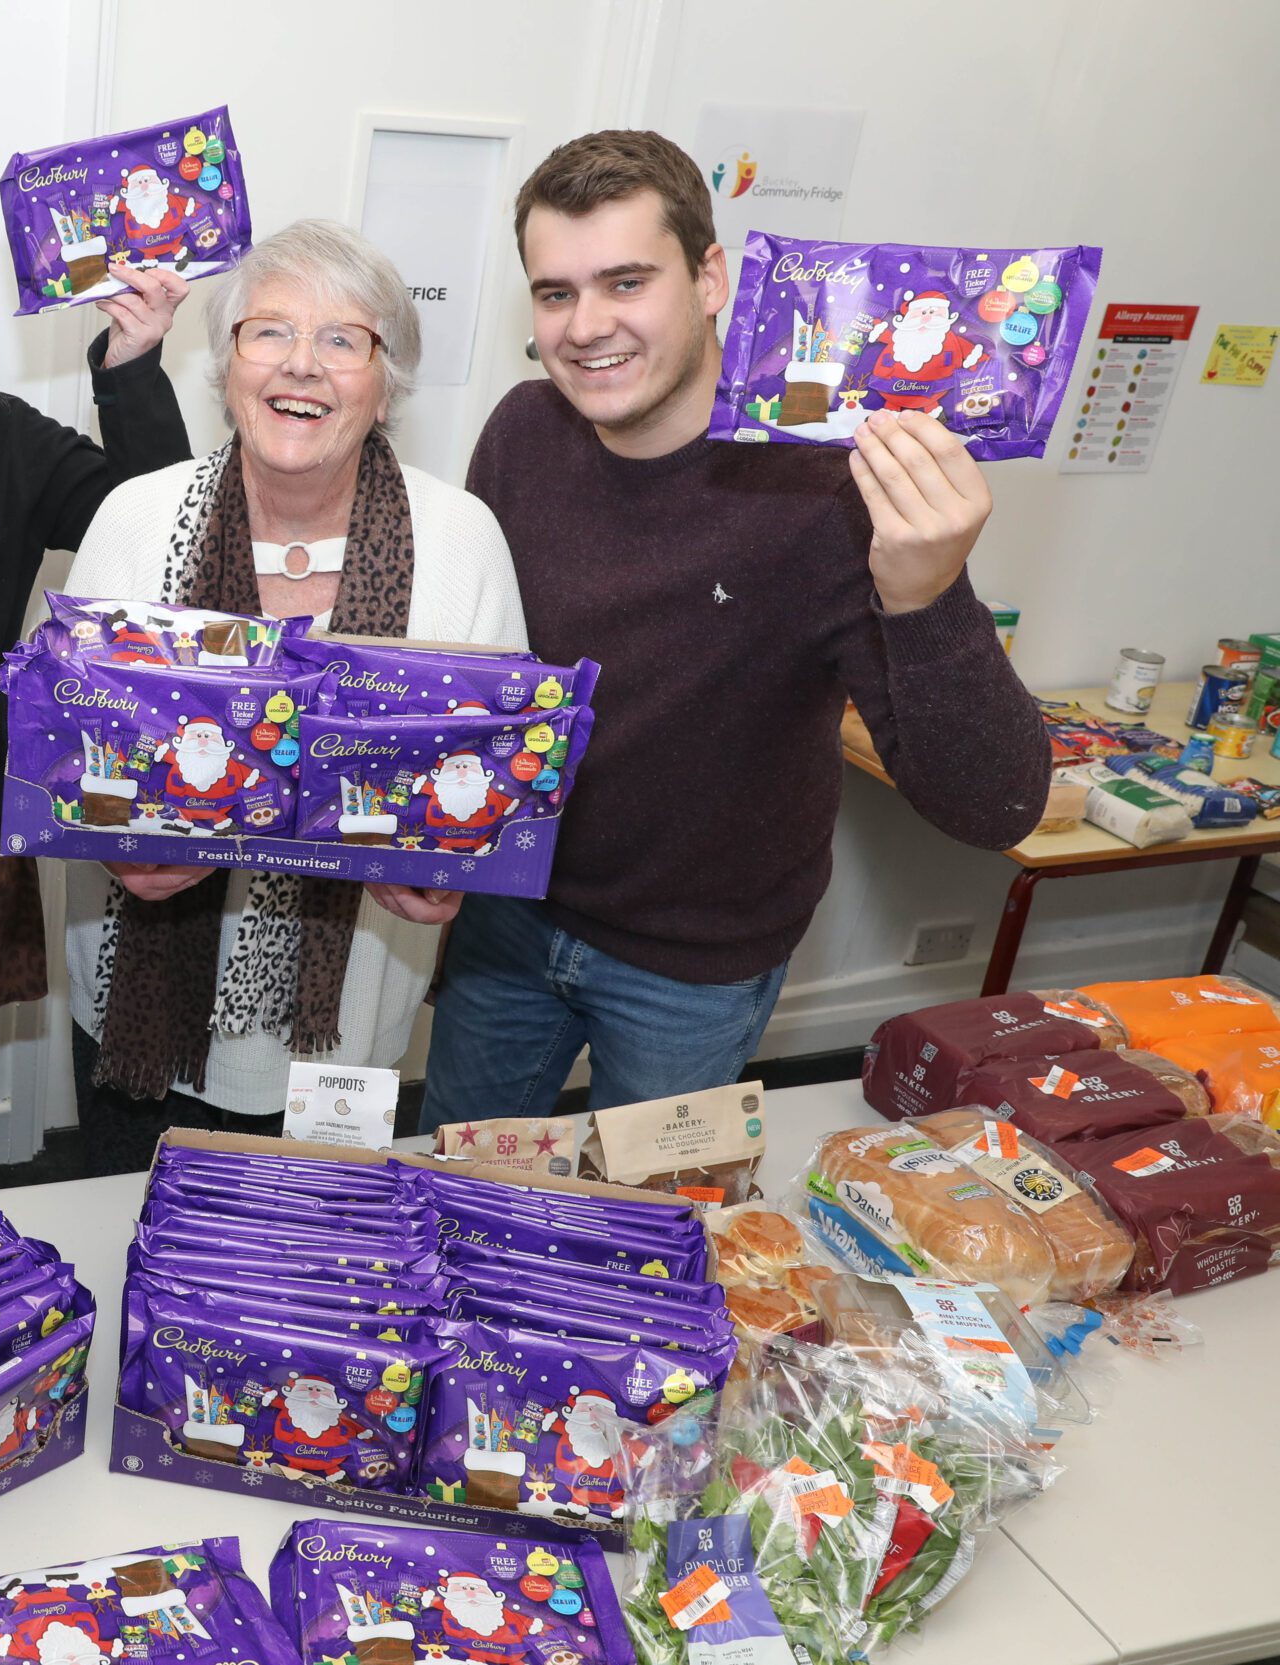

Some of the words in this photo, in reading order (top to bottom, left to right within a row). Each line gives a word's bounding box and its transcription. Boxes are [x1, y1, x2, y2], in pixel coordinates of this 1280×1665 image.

[157, 141, 178, 153] FREE
[19, 164, 88, 192] Cadbury
[752, 184, 810, 200] Community
[810, 186, 843, 202] Fridge
[773, 252, 867, 294] Cadbury
[966, 268, 992, 280] FREE
[965, 279, 987, 288] Ticket
[1114, 310, 1141, 322] Allergy
[1143, 312, 1185, 321] Awareness
[893, 380, 930, 393] Cadbury
[502, 686, 526, 696] FREE
[54, 678, 139, 718] Cadbury
[501, 695, 524, 703] Ticket
[231, 701, 256, 711] FREE
[232, 710, 255, 718] Ticket
[491, 733, 516, 742] FREE
[310, 733, 402, 759] Cadbury
[186, 797, 217, 808] Cadbury
[446, 827, 476, 836] Cadbury
[197, 851, 252, 862] Festive
[257, 853, 341, 870] Favourites!
[994, 1019, 1046, 1037] BAKERY
[318, 1075, 366, 1093] POPDOTS
[898, 1072, 932, 1100] BAKERY
[1083, 1089, 1141, 1103] BAKERY
[665, 1119, 702, 1131] BAKERY
[660, 1135, 676, 1144] MILK
[678, 1129, 716, 1141] CHOCOLATE
[659, 1143, 674, 1151] BALL
[676, 1136, 716, 1149] DOUGHNUTS
[844, 1183, 893, 1230] Danish
[606, 1259, 631, 1272] FREE
[1205, 1256, 1236, 1277] TOASTIE
[955, 1315, 984, 1323] STICKY
[955, 1320, 992, 1330] MUFFINS
[12, 1331, 32, 1346] FREE
[153, 1326, 247, 1367] Cadbury
[346, 1364, 372, 1378] FREE
[626, 1377, 653, 1389] FREE
[296, 1445, 329, 1457] Cadbury
[325, 1494, 384, 1512] Festive
[388, 1505, 479, 1526] Favourites!
[298, 1535, 392, 1569] Cadbury
[490, 1556, 517, 1567] FREE
[727, 1558, 745, 1573] OF
[493, 1565, 517, 1573] Ticket
[472, 1640, 506, 1652] Cadbury
